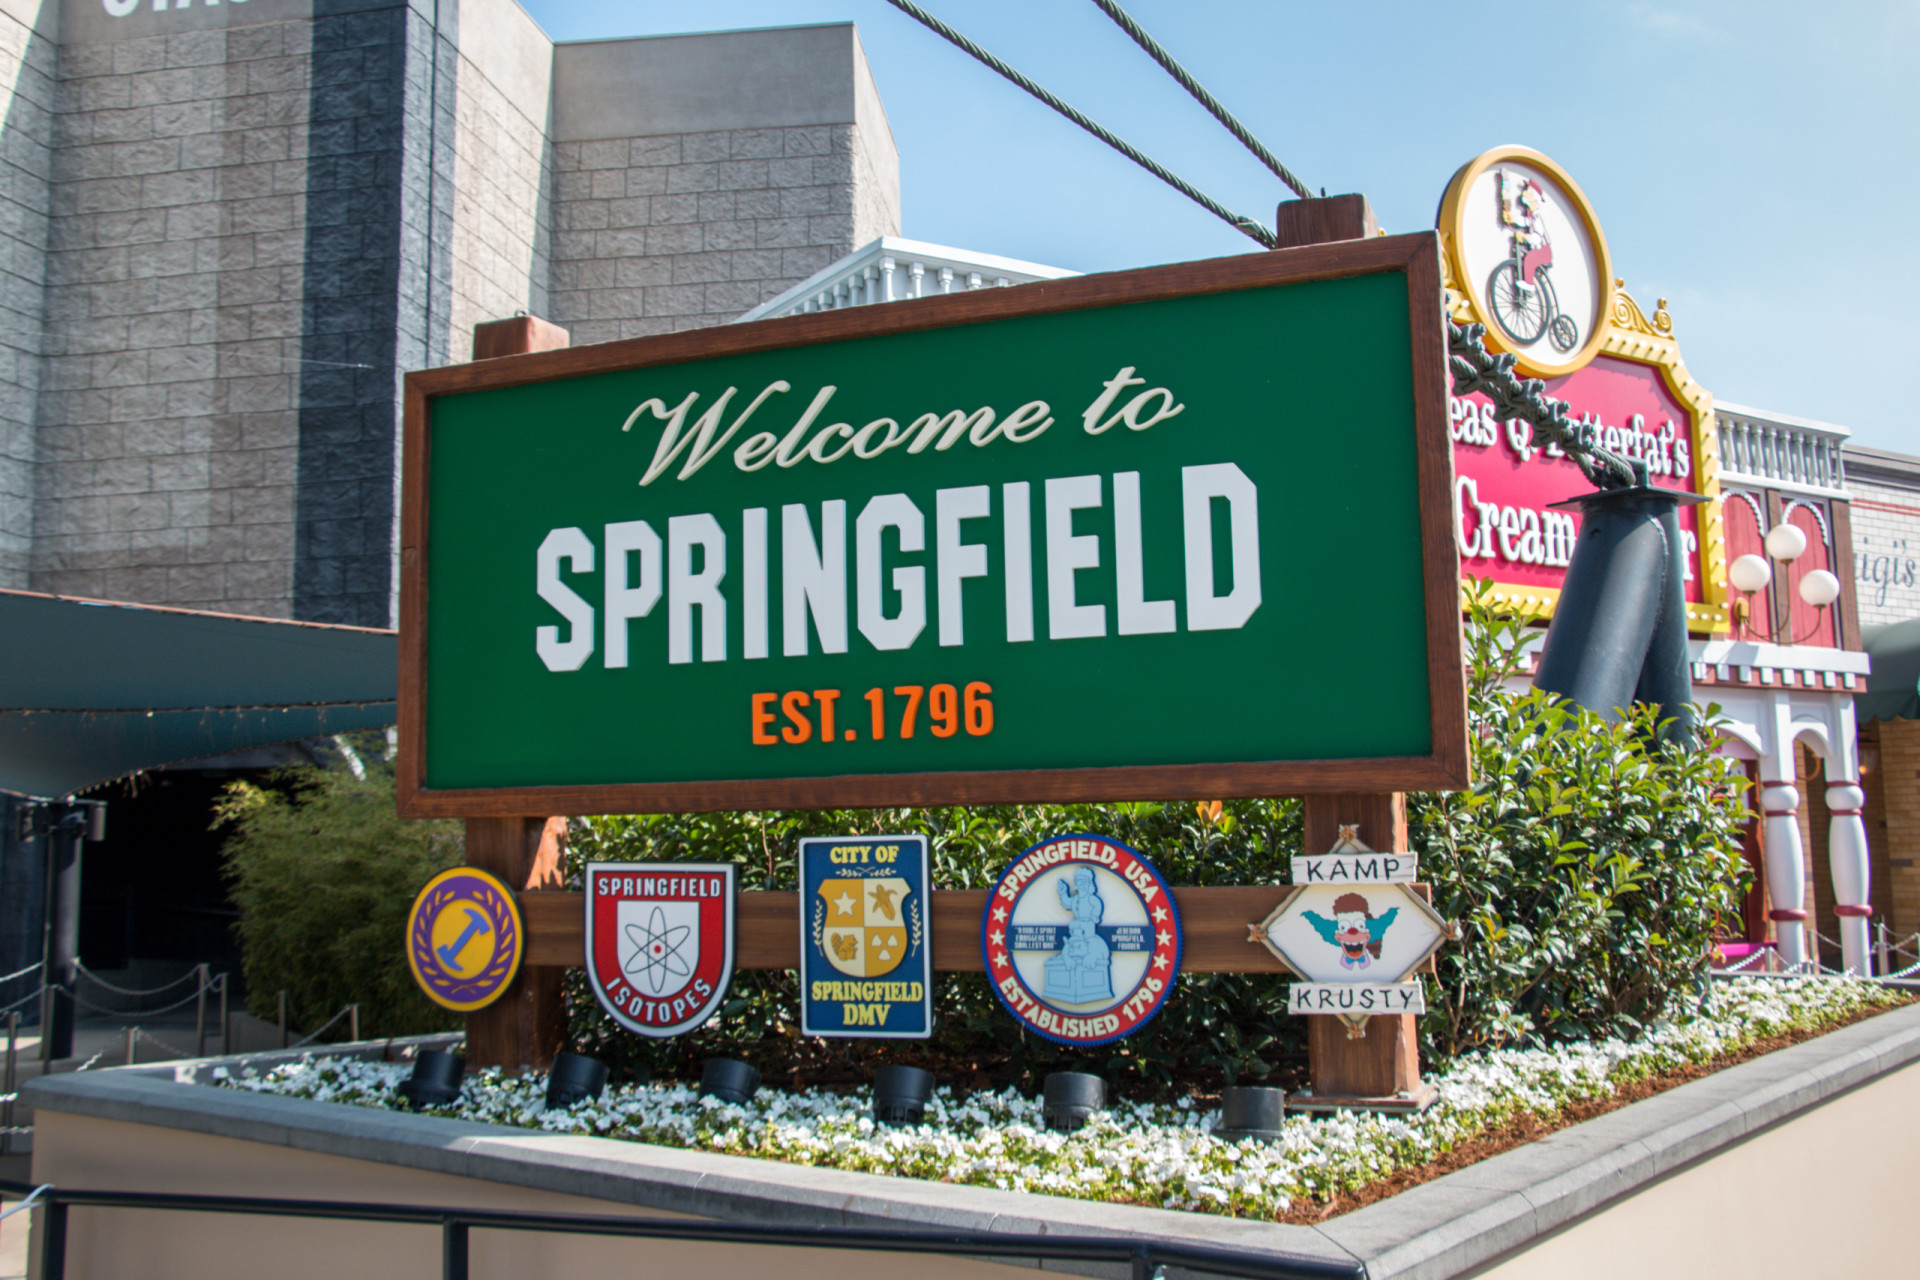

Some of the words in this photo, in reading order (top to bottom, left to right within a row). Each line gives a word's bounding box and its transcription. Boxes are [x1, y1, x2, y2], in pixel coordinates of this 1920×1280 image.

[622, 380, 1054, 487] Welcome
[1082, 366, 1185, 436] to
[1455, 475, 1577, 567] Cream
[536, 462, 1262, 672] SPRINGFIELD
[830, 846, 872, 864] CITY
[875, 845, 900, 863] OF
[998, 840, 1119, 902] SPRINGFIELD,
[1124, 860, 1159, 903] USA
[1306, 857, 1400, 882] KAMP
[598, 877, 721, 897] SPRINGFIELD
[606, 977, 711, 1023] ISOTOPES
[811, 981, 923, 1002] SPRINGFIELD
[1000, 976, 1119, 1037] ESTABLISHED
[1122, 977, 1163, 1021] 1796
[1297, 988, 1413, 1009] KRUSTY
[843, 1004, 890, 1026] DMV
